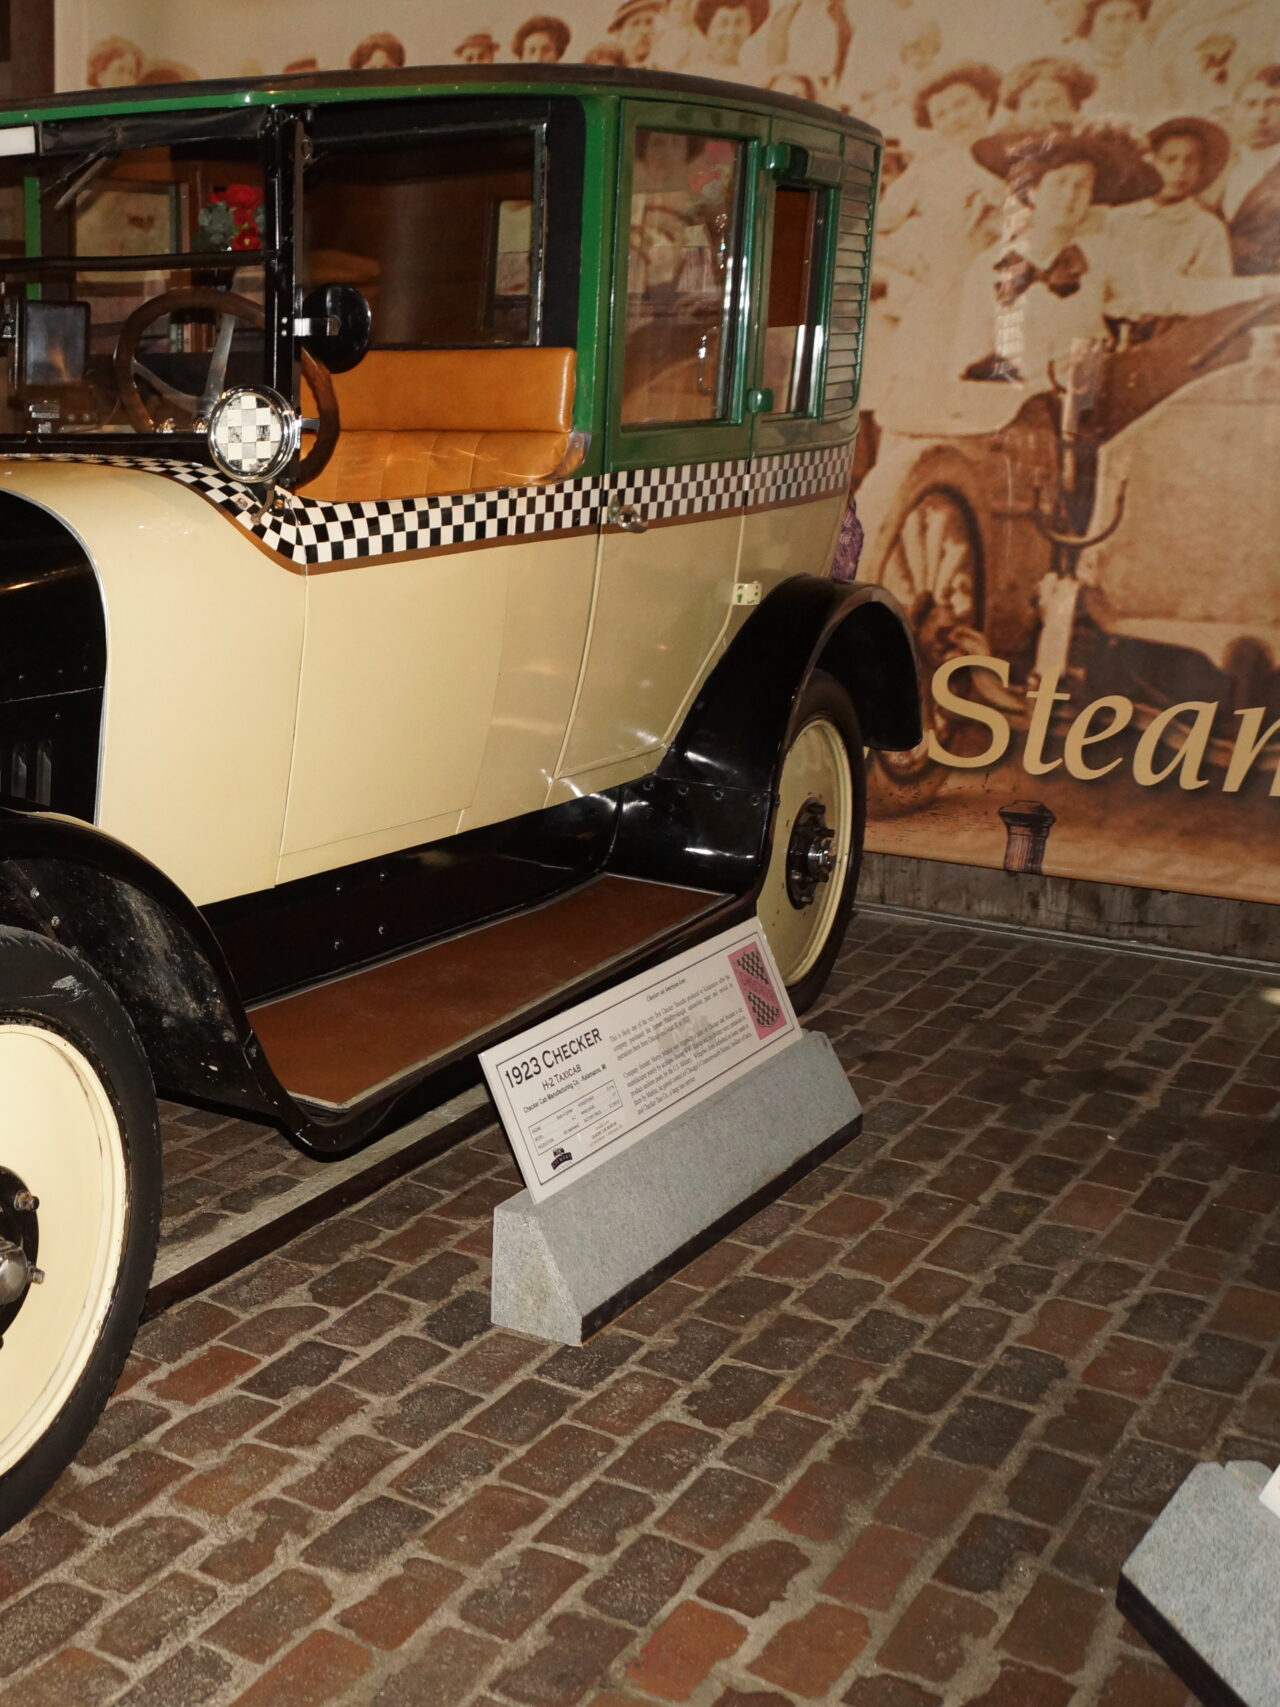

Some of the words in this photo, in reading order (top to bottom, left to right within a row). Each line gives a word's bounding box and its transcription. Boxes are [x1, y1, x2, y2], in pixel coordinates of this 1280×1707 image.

[506, 1057, 541, 1088] 1923
[542, 1028, 602, 1068] CHECKER
[542, 1077, 555, 1090] H-2
[554, 1064, 581, 1083] TAXICAB
[523, 1102, 539, 1113] Checker
[547, 1083, 573, 1100] Manufacturing
